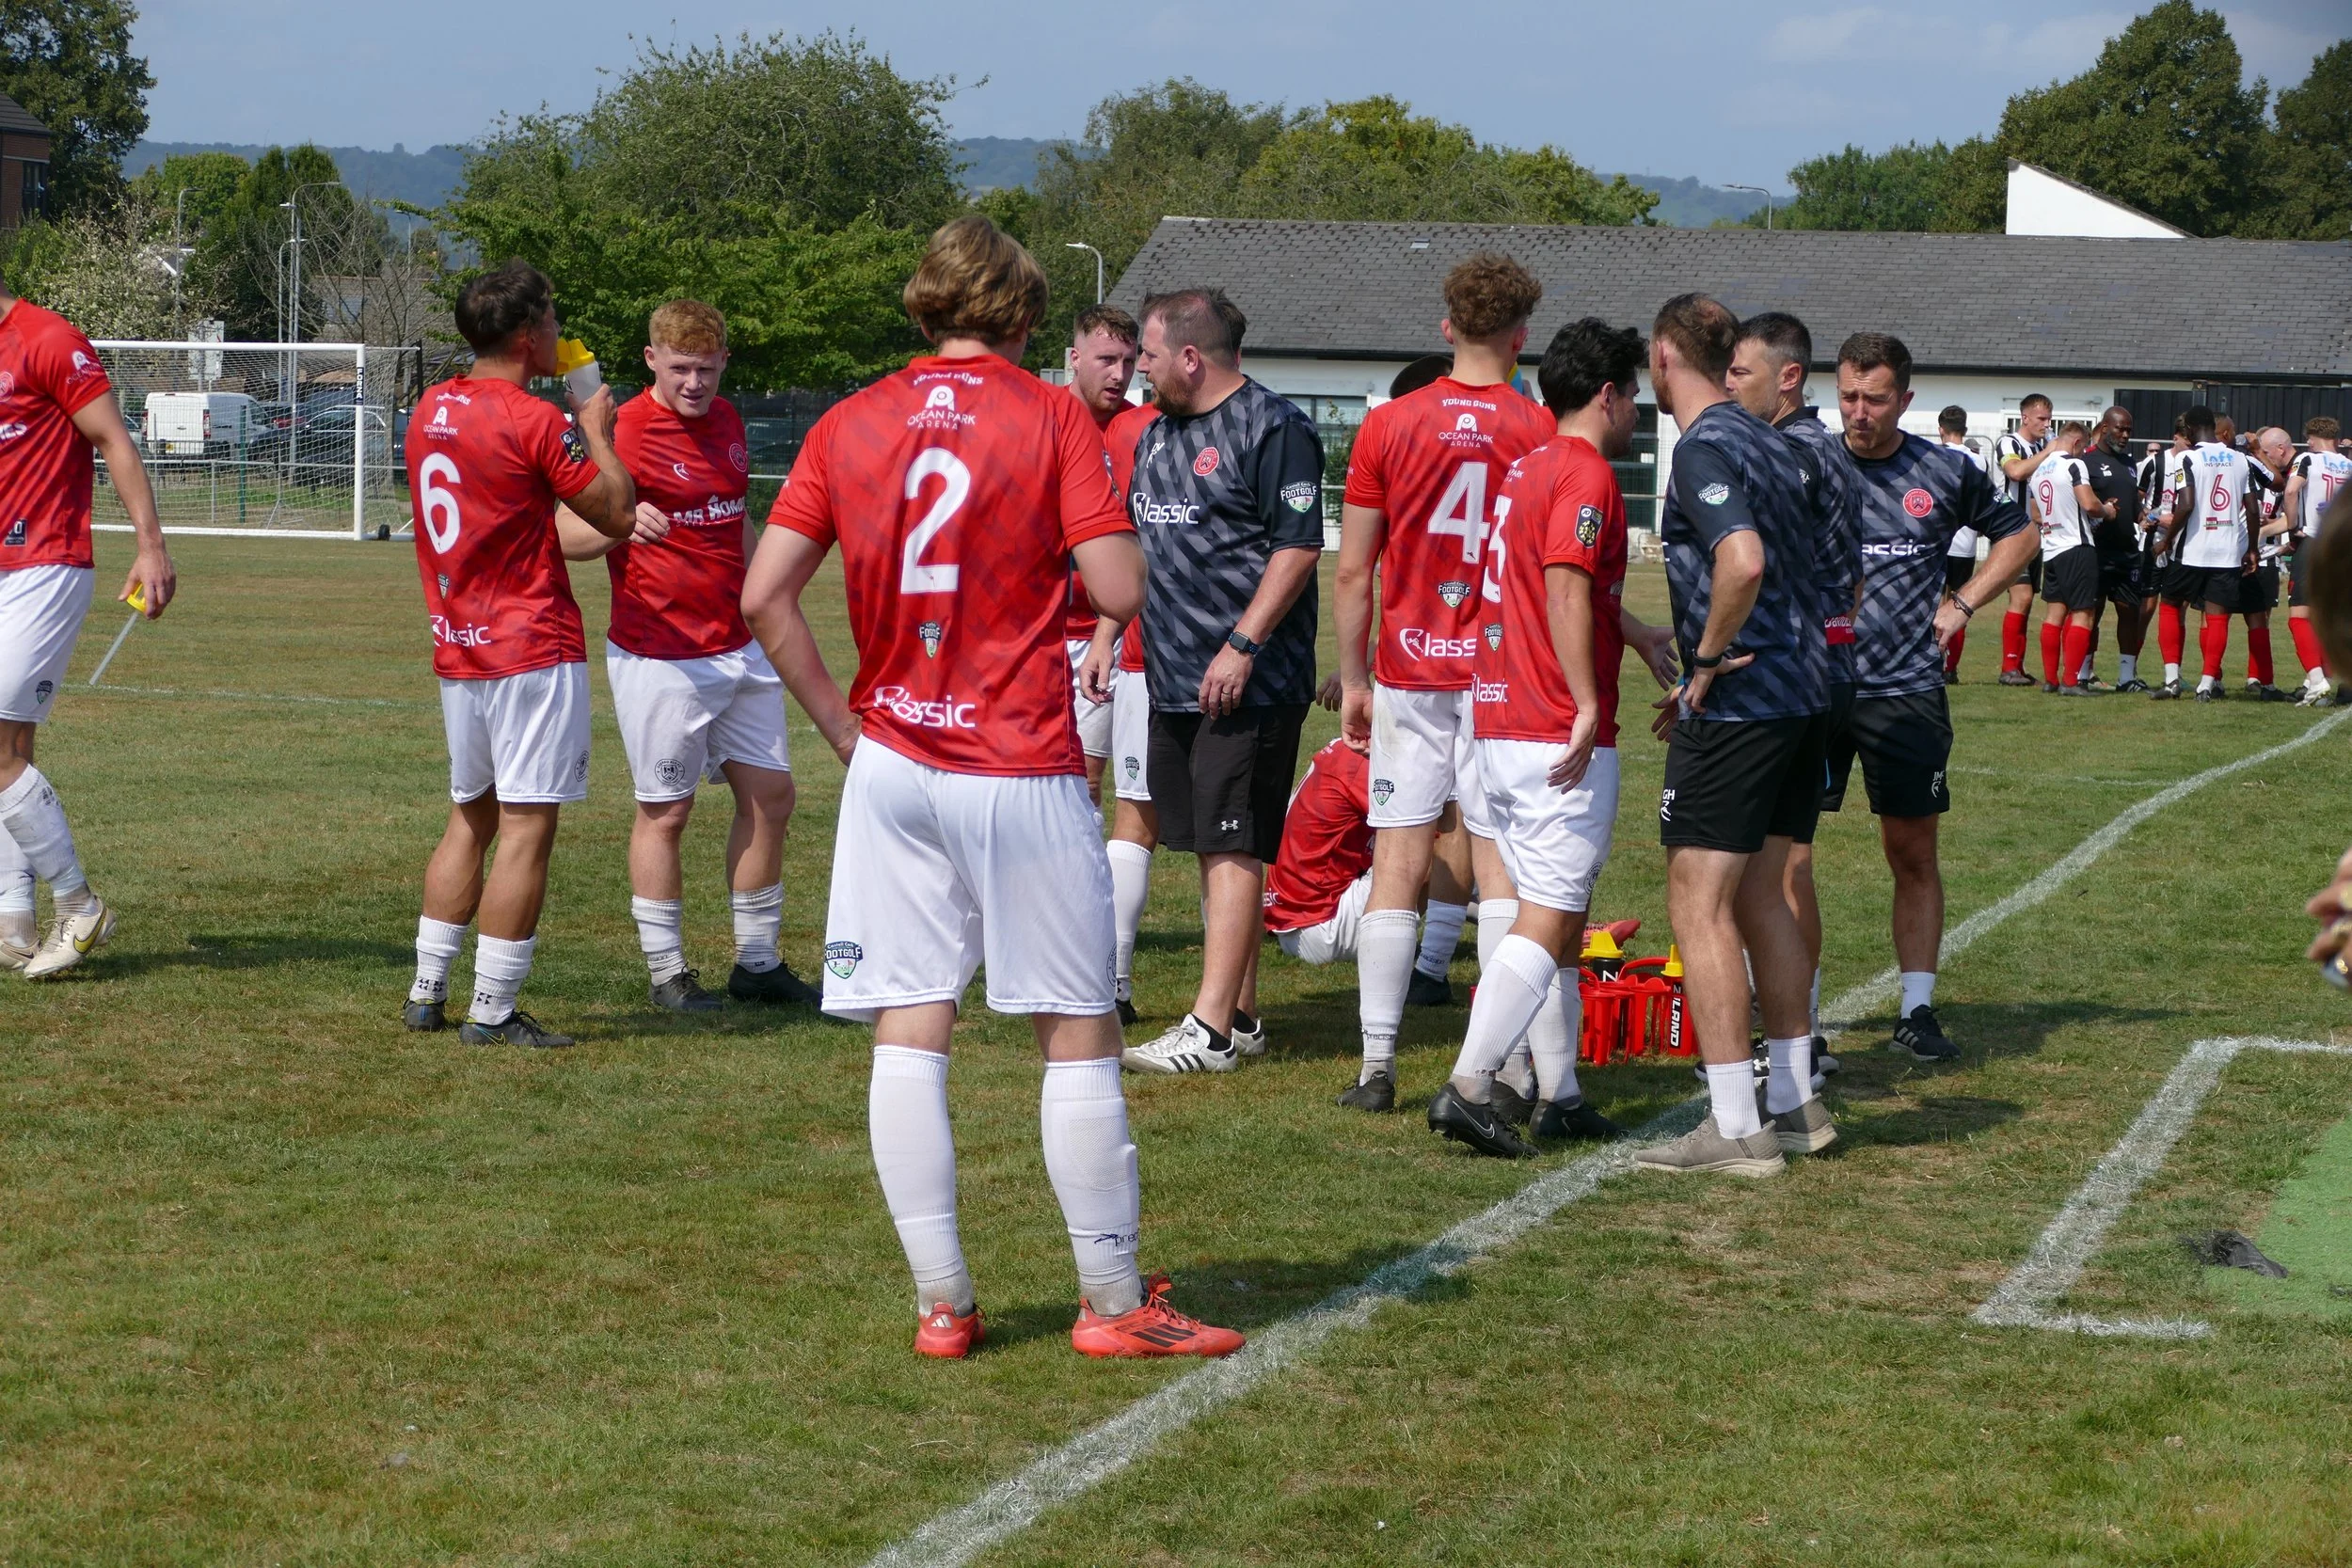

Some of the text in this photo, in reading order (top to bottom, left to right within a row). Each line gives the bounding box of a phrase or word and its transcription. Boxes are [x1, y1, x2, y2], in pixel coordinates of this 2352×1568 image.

[1442, 398, 1497, 411] YOUNG GUNS
[907, 409, 976, 425] OCEAN PARK
[917, 420, 958, 430] ARENA
[1438, 432, 1494, 444] OCEAN PARK
[1280, 485, 1317, 501] FOOTGOLF
[2038, 480, 2054, 516] 9
[2209, 473, 2231, 512] 6
[420, 451, 461, 555] 6
[707, 497, 746, 520] HOM
[1133, 492, 1200, 527] Classic
[900, 447, 971, 594] 2
[1427, 461, 1491, 564] 4
[1438, 585, 1470, 595] FOOTGOLF
[1662, 788, 1676, 800] GH
[825, 946, 862, 958] OOTGOLF
